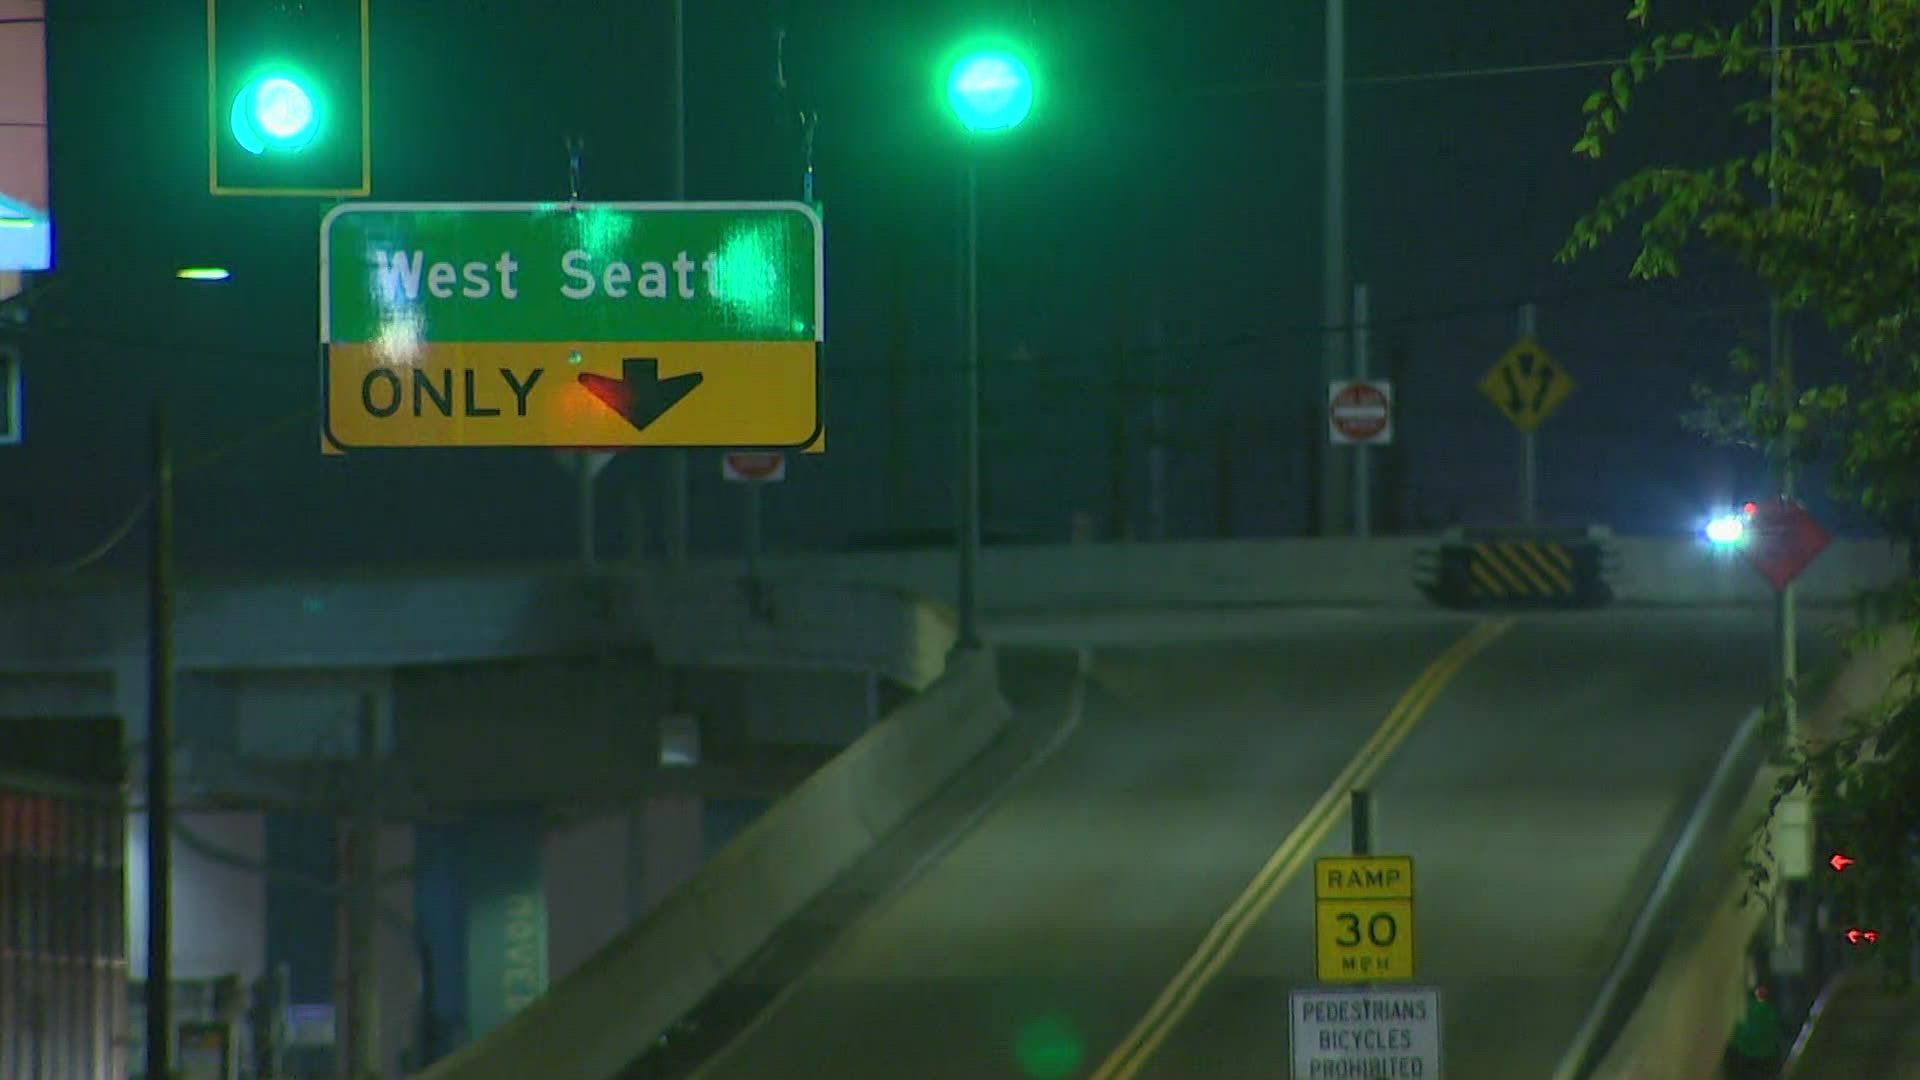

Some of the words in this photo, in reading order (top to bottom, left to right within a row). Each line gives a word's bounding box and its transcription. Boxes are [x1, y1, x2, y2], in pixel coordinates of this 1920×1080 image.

[375, 249, 519, 300] West
[560, 249, 774, 300] Seatt
[361, 367, 544, 419] ONLY
[1327, 869, 1400, 888] RAMP
[1336, 911, 1397, 948] 30
[1342, 956, 1390, 973] MPH
[1302, 998, 1427, 1023] PEDESTRIANS
[1319, 1028, 1411, 1051] BICYCLES
[1310, 1056, 1423, 1079] PROHIBITED
